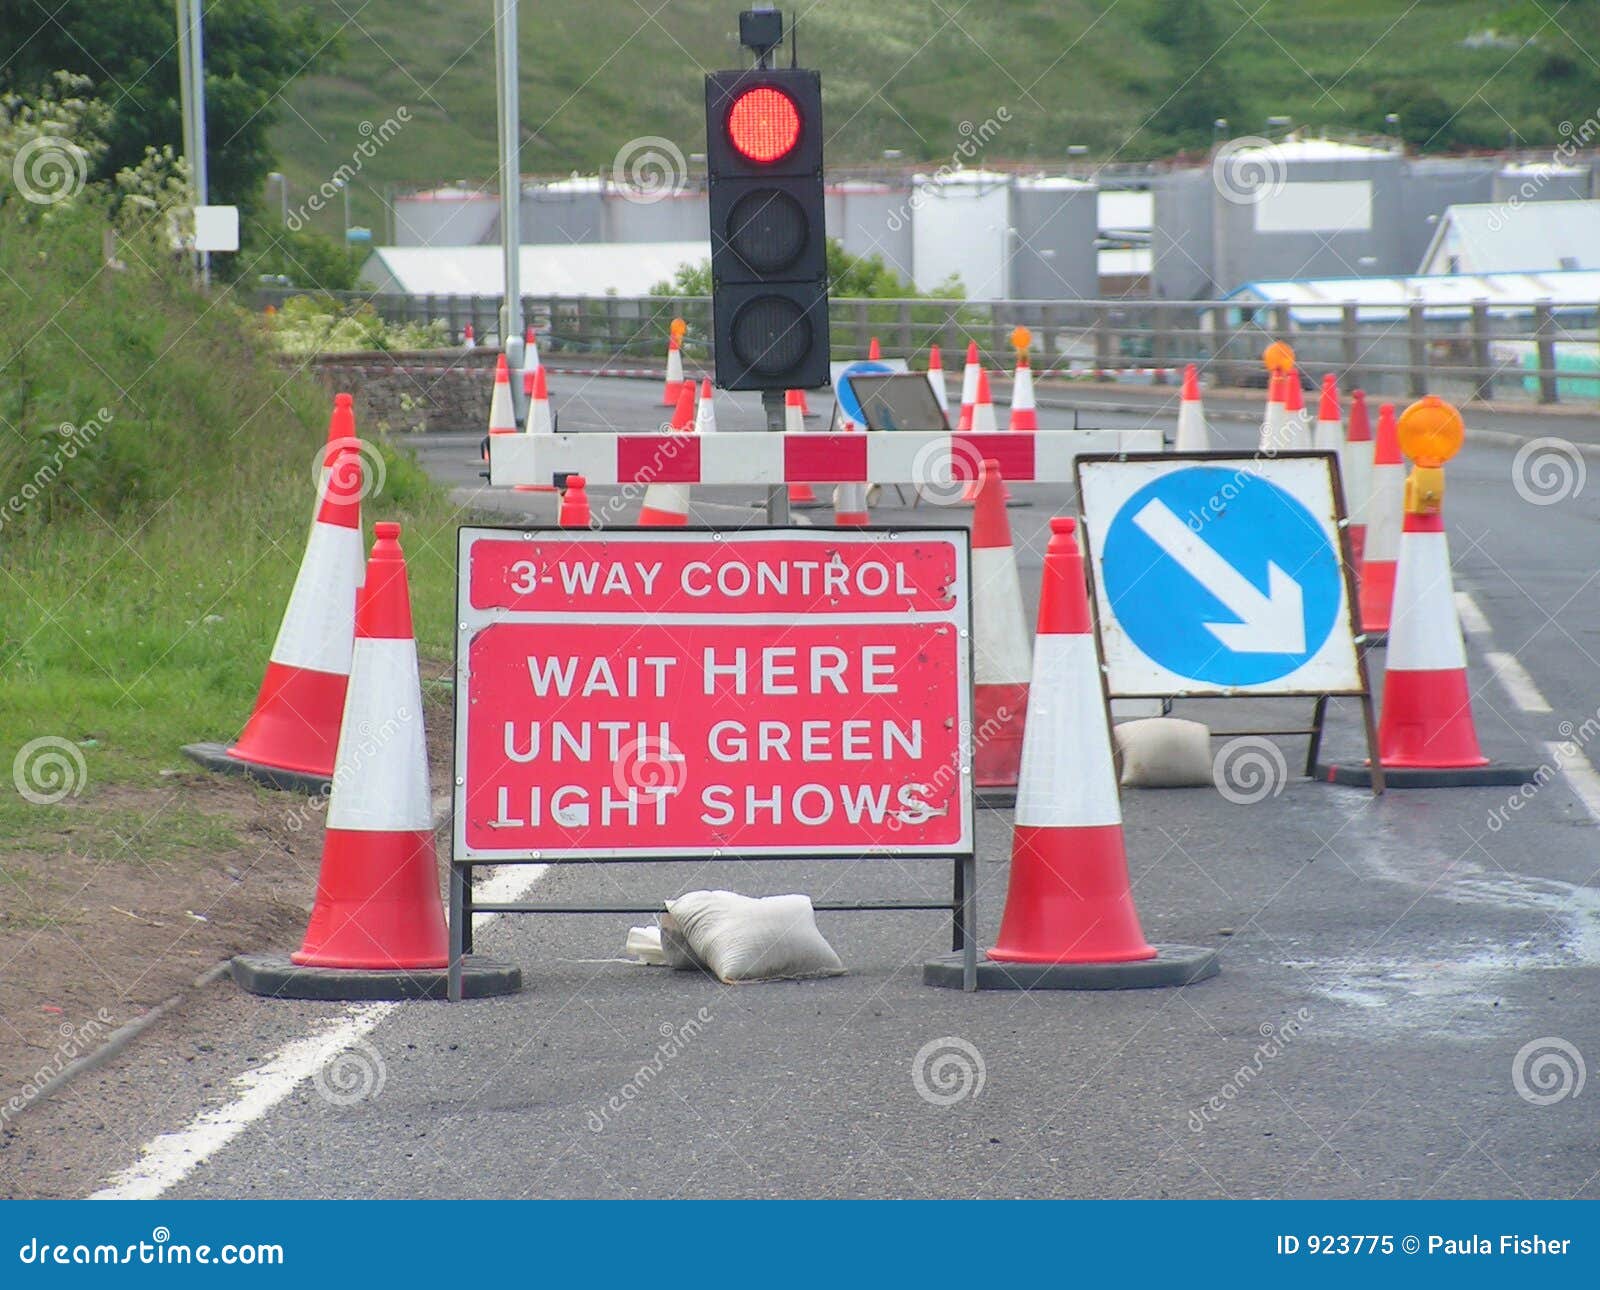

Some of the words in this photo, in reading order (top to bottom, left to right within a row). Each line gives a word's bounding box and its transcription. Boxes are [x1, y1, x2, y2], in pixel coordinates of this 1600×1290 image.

[510, 560, 663, 596] 3-WAY
[681, 560, 918, 597] CONTROL
[527, 655, 677, 697] WAIT
[703, 645, 899, 695] HERE
[504, 721, 686, 763] UNTIL
[707, 719, 923, 763] GREEN
[497, 785, 678, 828] LIGHT
[700, 783, 932, 826] SHOWS
